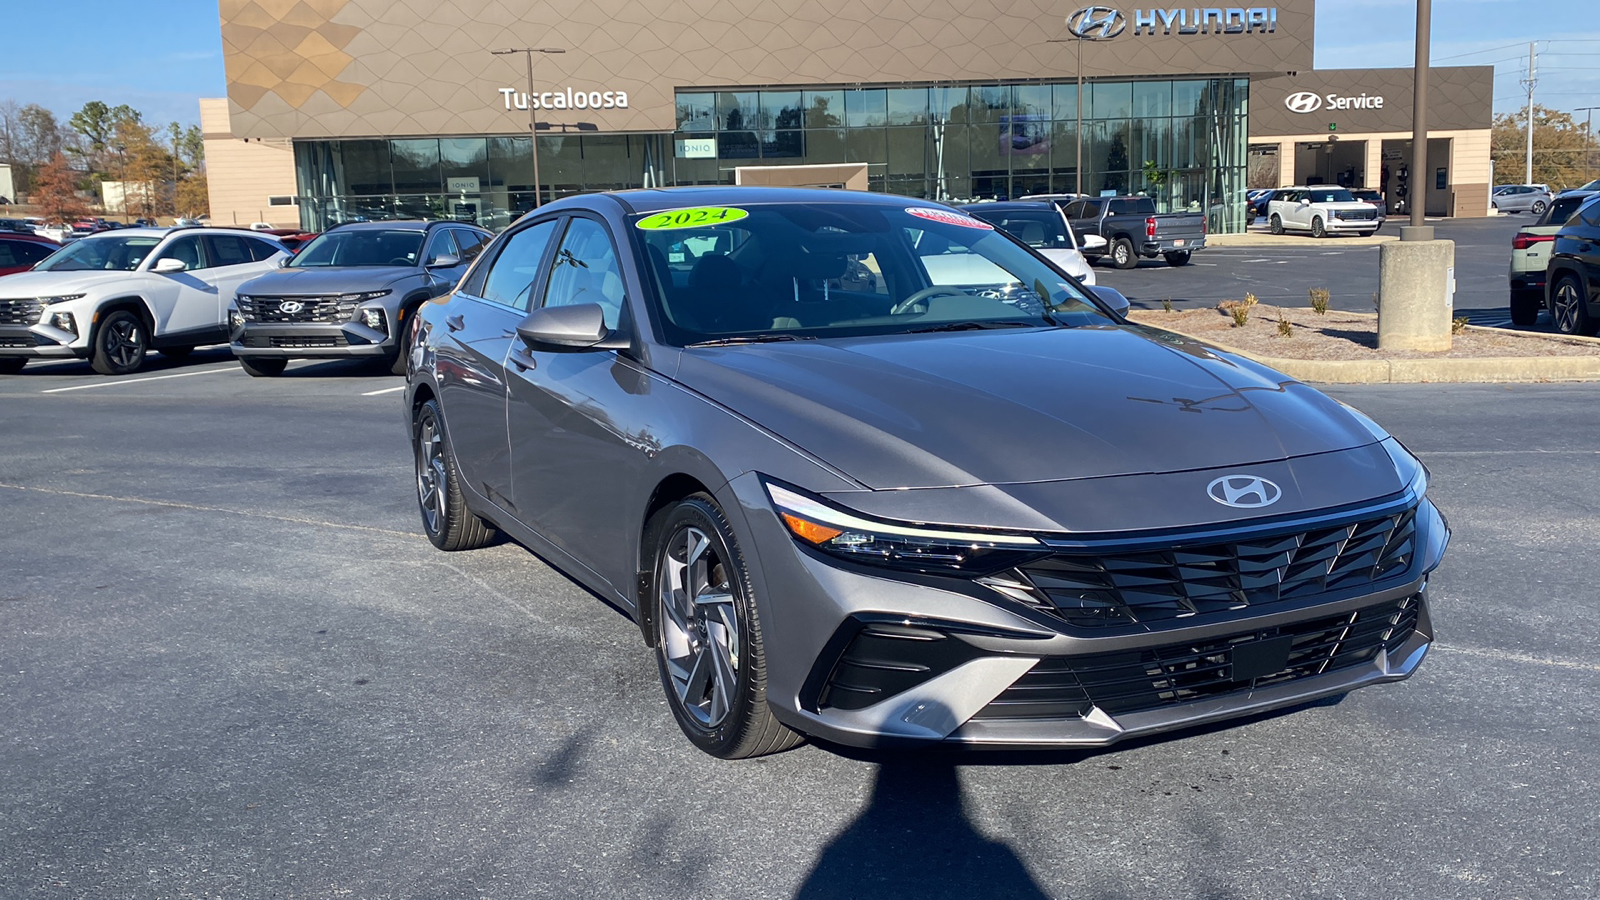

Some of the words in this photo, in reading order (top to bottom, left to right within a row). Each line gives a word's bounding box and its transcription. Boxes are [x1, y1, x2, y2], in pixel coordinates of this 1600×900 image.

[1135, 7, 1277, 35] HYUNDAI
[498, 87, 628, 110] Tuscaloosa
[1326, 93, 1383, 109] Service
[680, 144, 710, 152] IONIQ
[657, 208, 728, 228] 2024
